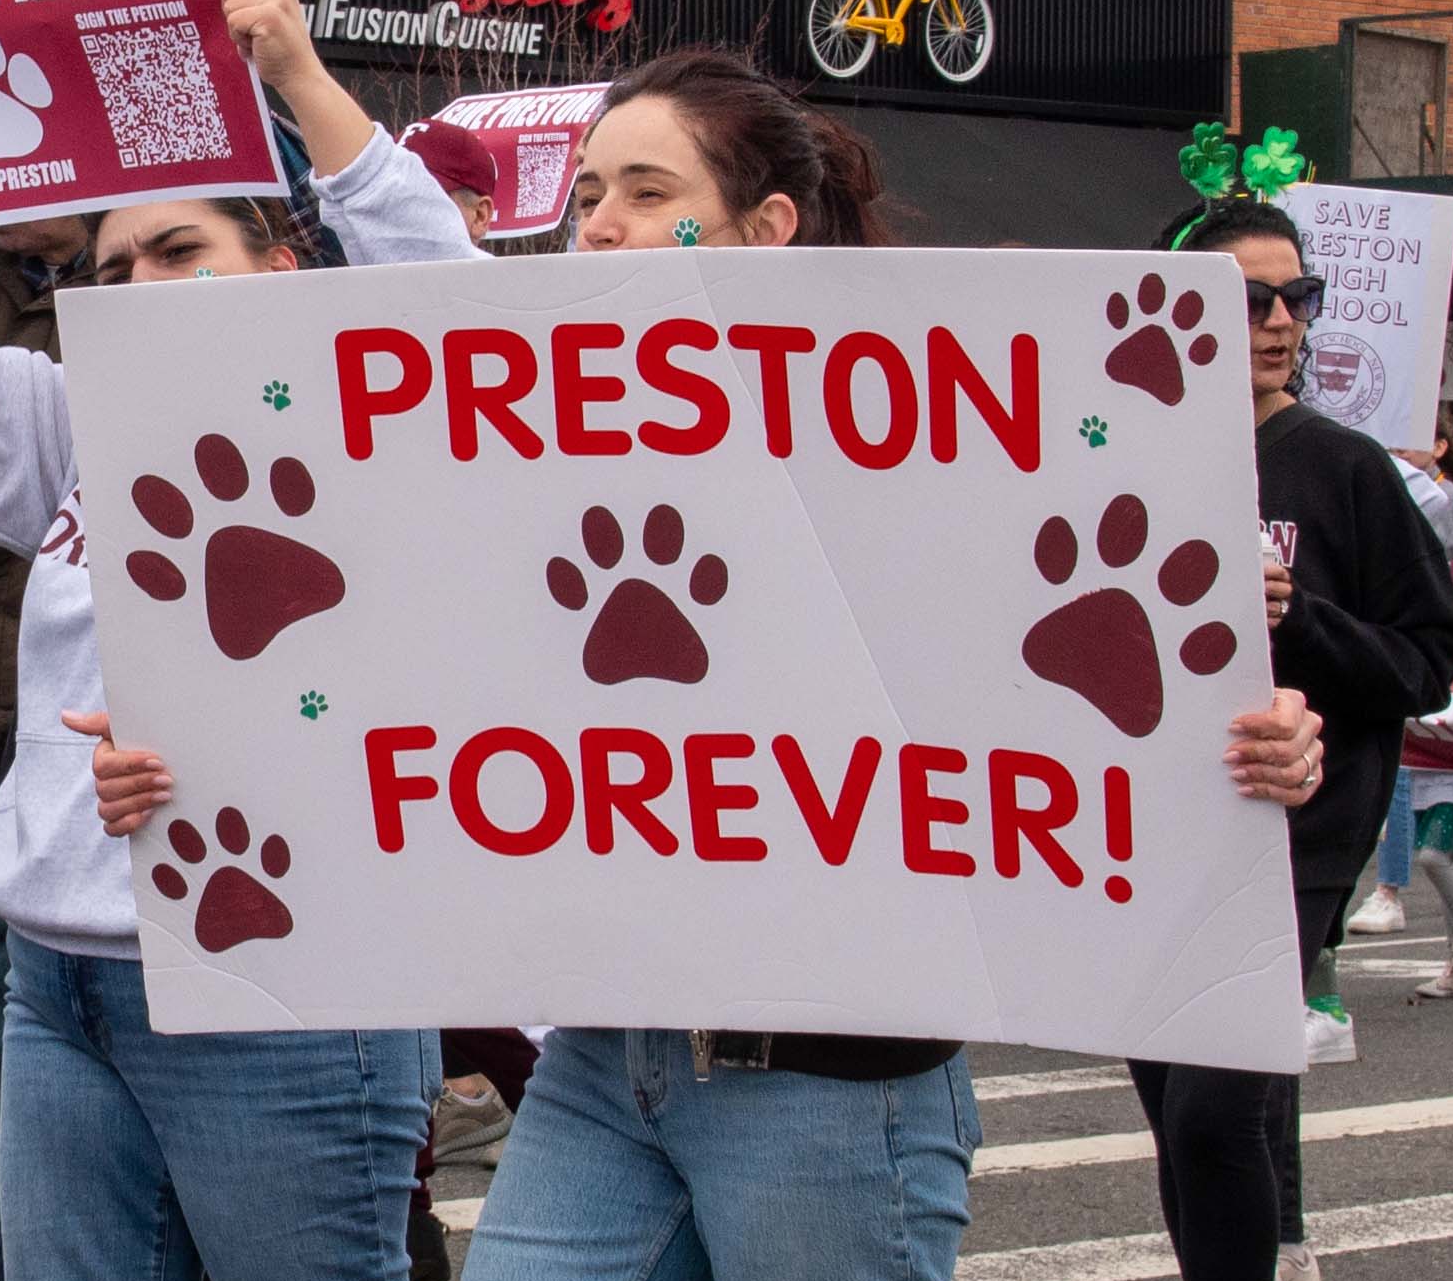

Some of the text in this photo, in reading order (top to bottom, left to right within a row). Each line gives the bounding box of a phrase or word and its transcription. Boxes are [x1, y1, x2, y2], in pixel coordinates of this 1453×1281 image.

[74, 0, 189, 30] SIGN THE PETITION
[485, 90, 605, 130] PRESTON!
[1314, 199, 1391, 231] SAVE
[1297, 229, 1422, 265] RESTON
[1319, 295, 1408, 327] HOOL
[333, 318, 1041, 474] PRESTON
[363, 723, 1134, 905] FOREVER!
